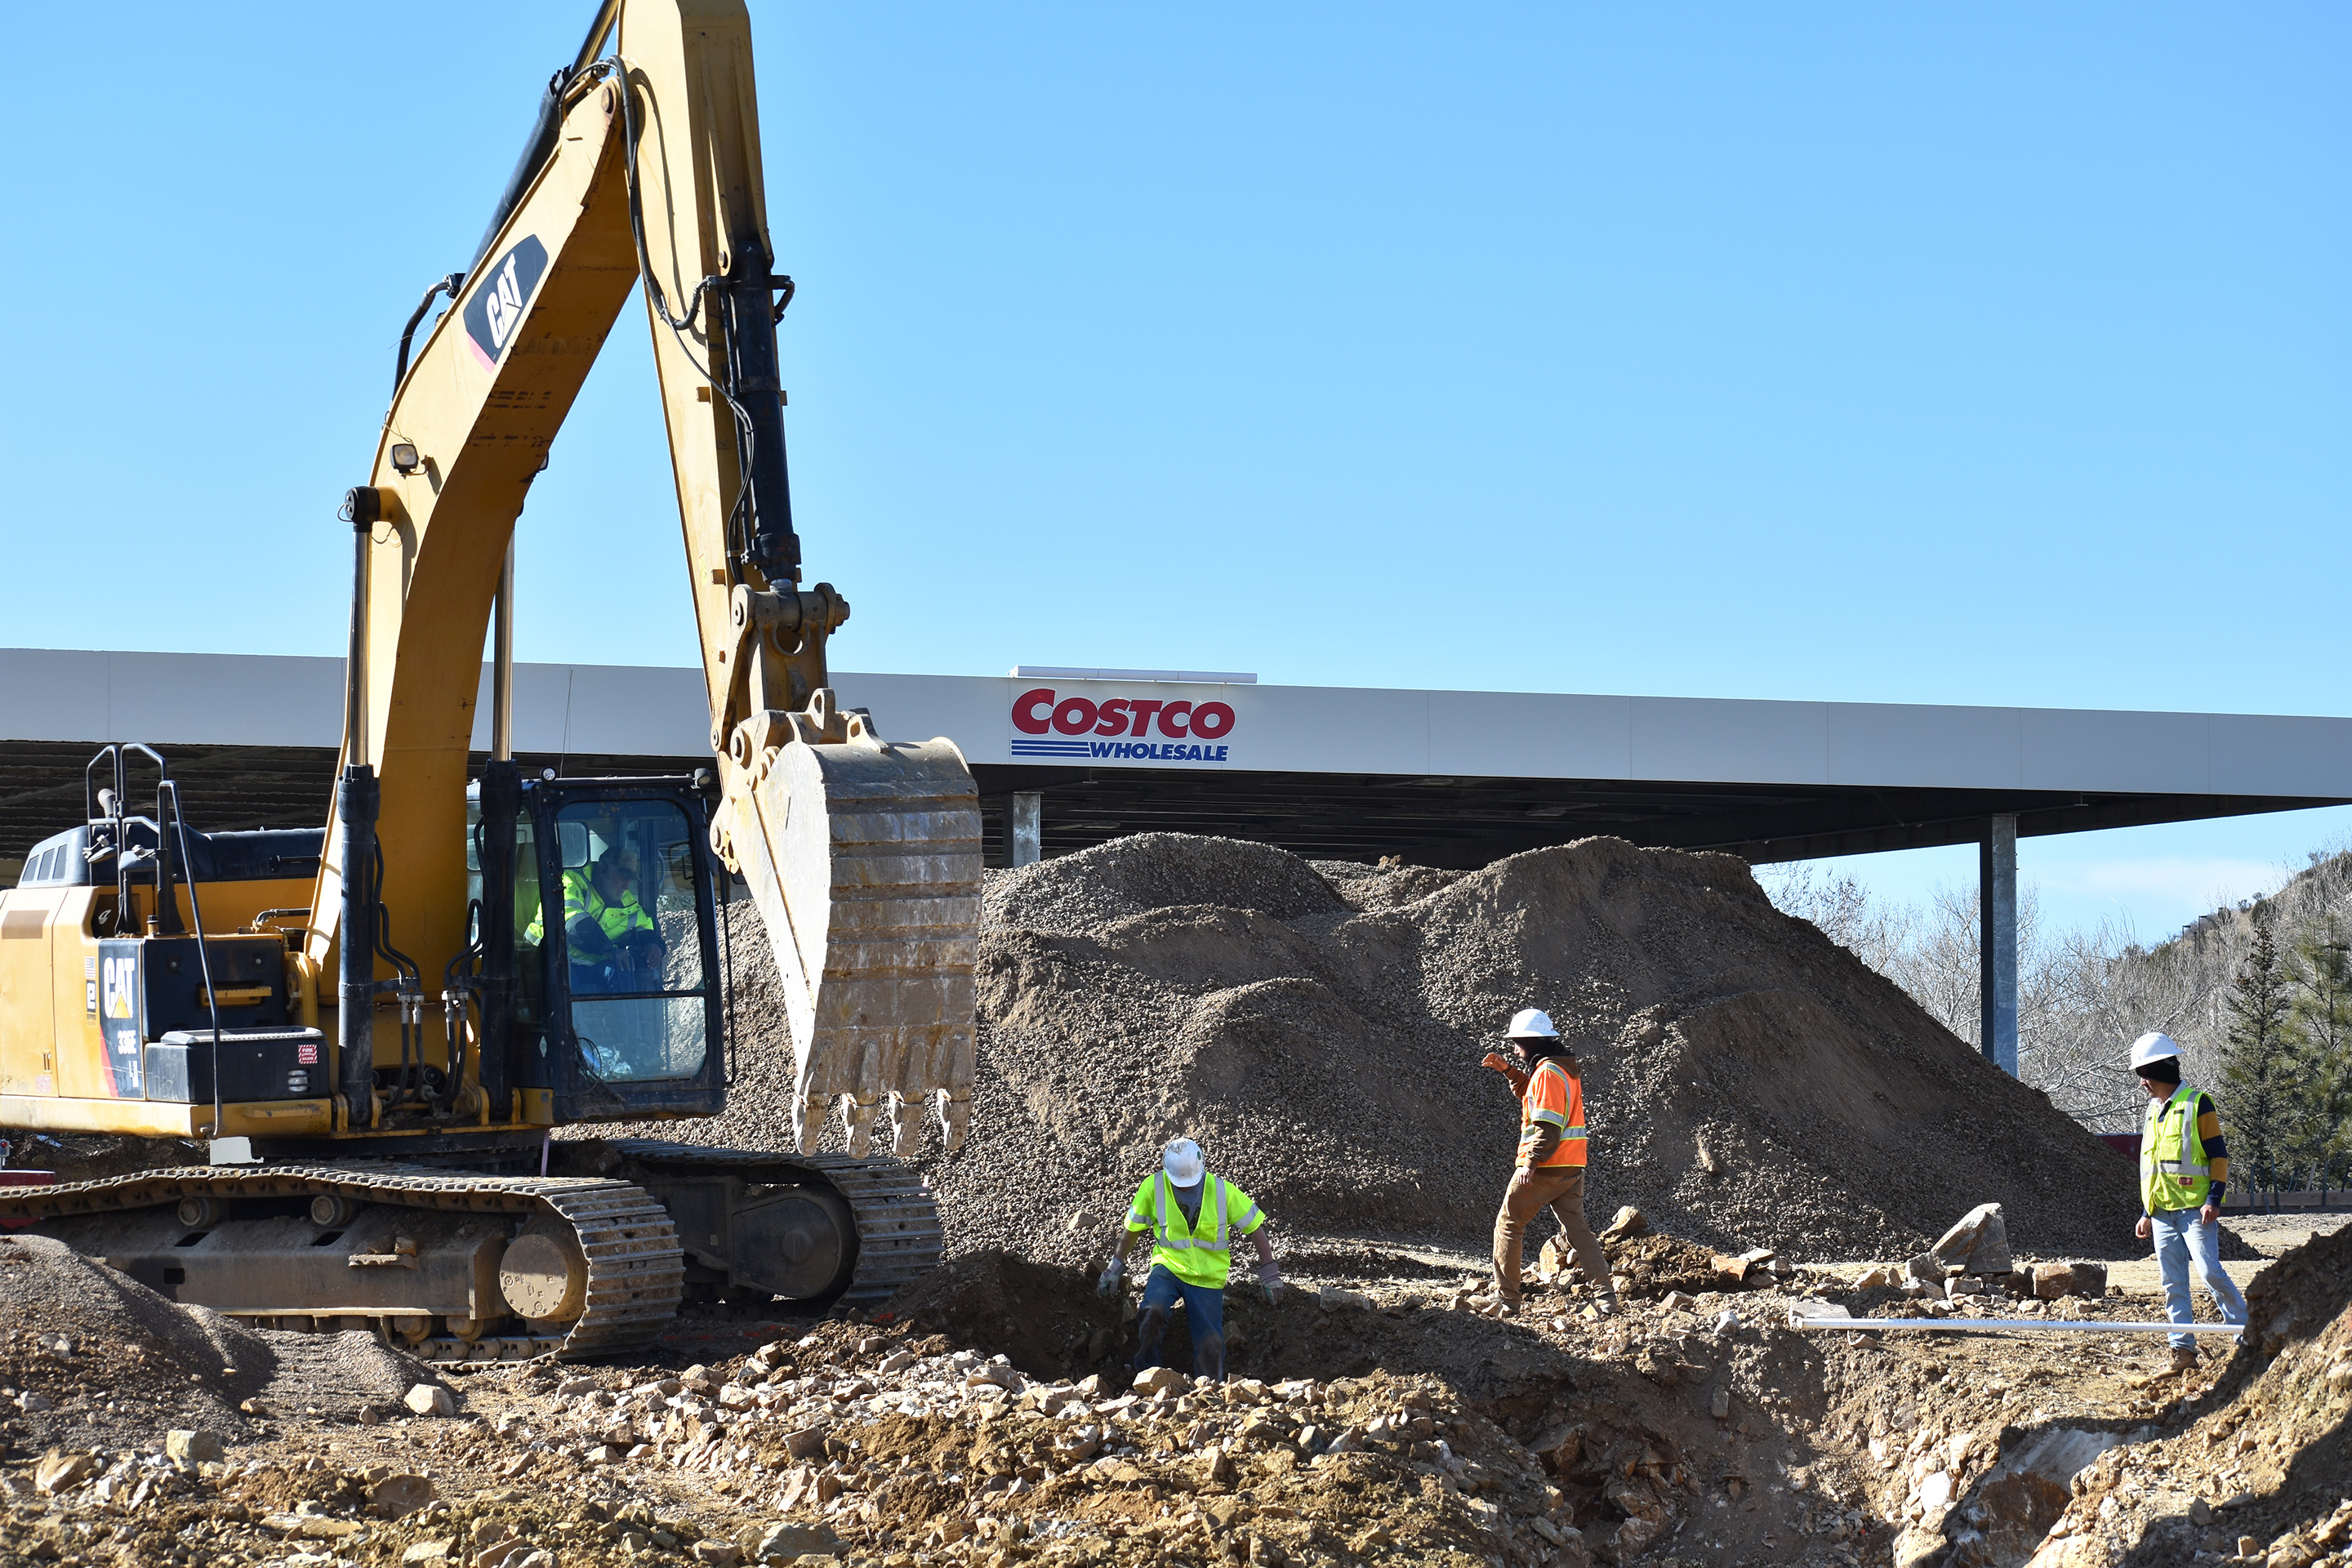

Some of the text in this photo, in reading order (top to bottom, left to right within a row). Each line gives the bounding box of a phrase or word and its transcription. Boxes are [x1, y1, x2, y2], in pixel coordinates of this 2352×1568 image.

[487, 253, 523, 349] CAT
[1011, 688, 1236, 739] COSTCO
[1089, 742, 1229, 762] WHOLESALE
[104, 957, 136, 1018] CAT
